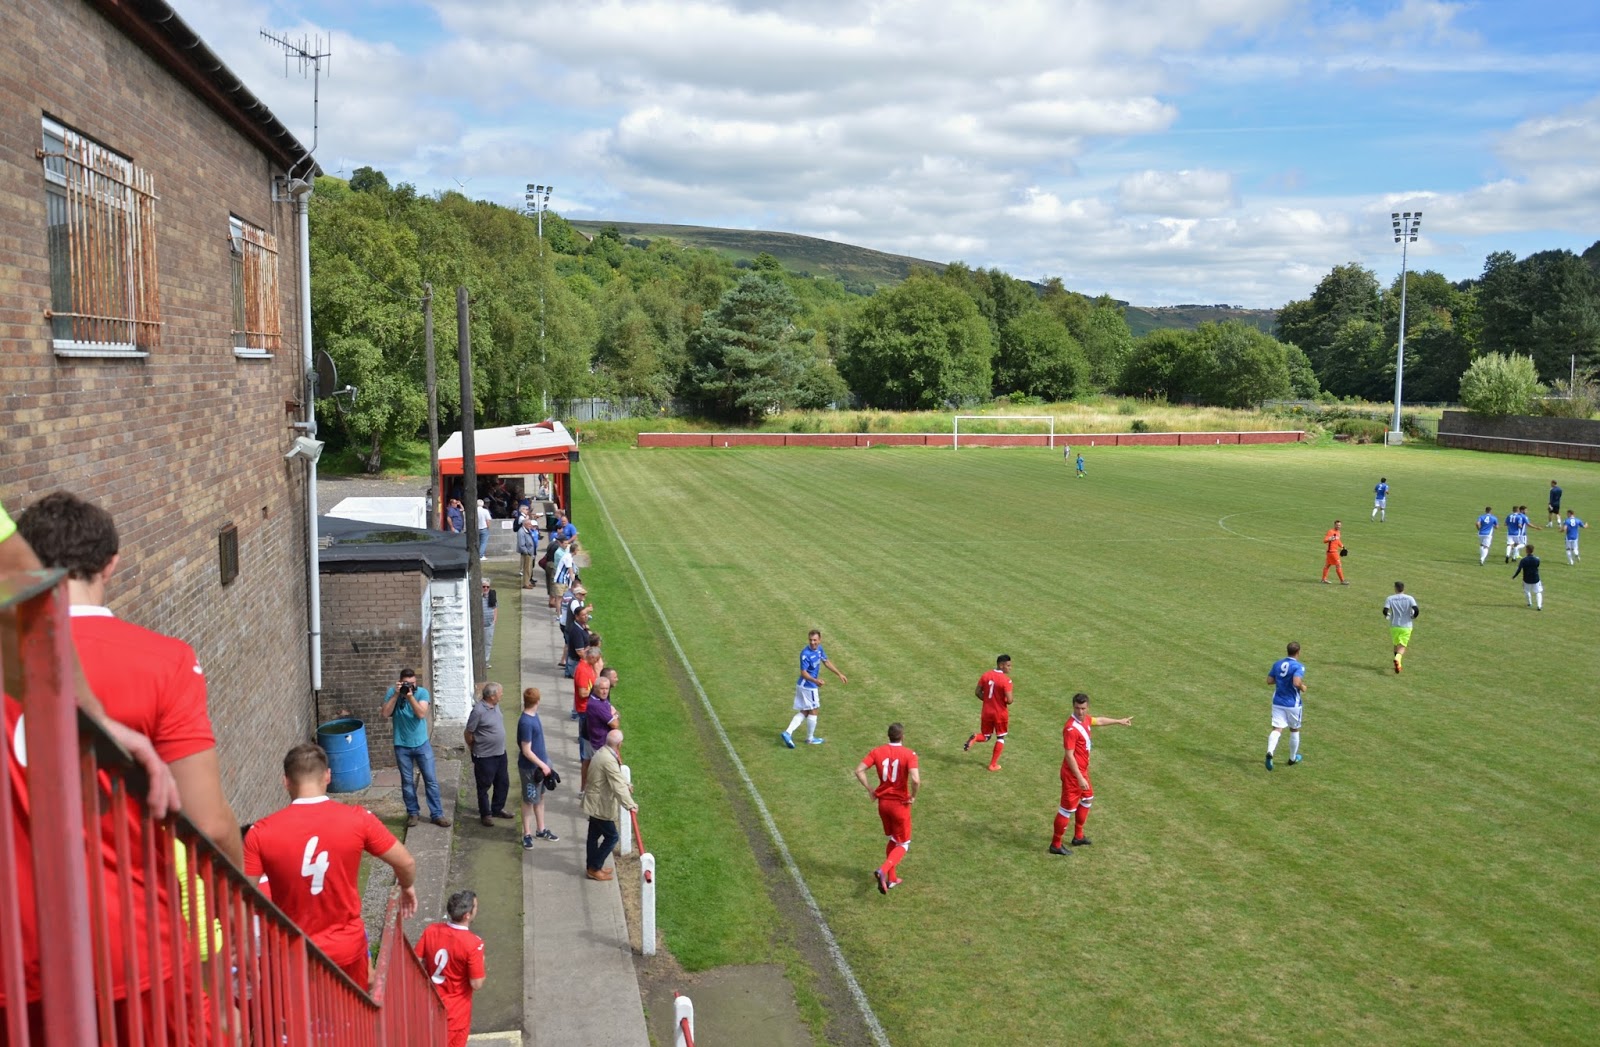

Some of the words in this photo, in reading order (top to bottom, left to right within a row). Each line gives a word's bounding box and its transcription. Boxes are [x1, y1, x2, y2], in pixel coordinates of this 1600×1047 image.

[1484, 516, 1490, 525] 4
[1509, 514, 1516, 523] 11
[1569, 518, 1576, 527] 8
[1280, 661, 1290, 678] 9
[881, 757, 900, 783] 11
[301, 835, 330, 896] 4
[431, 948, 449, 984] 2
